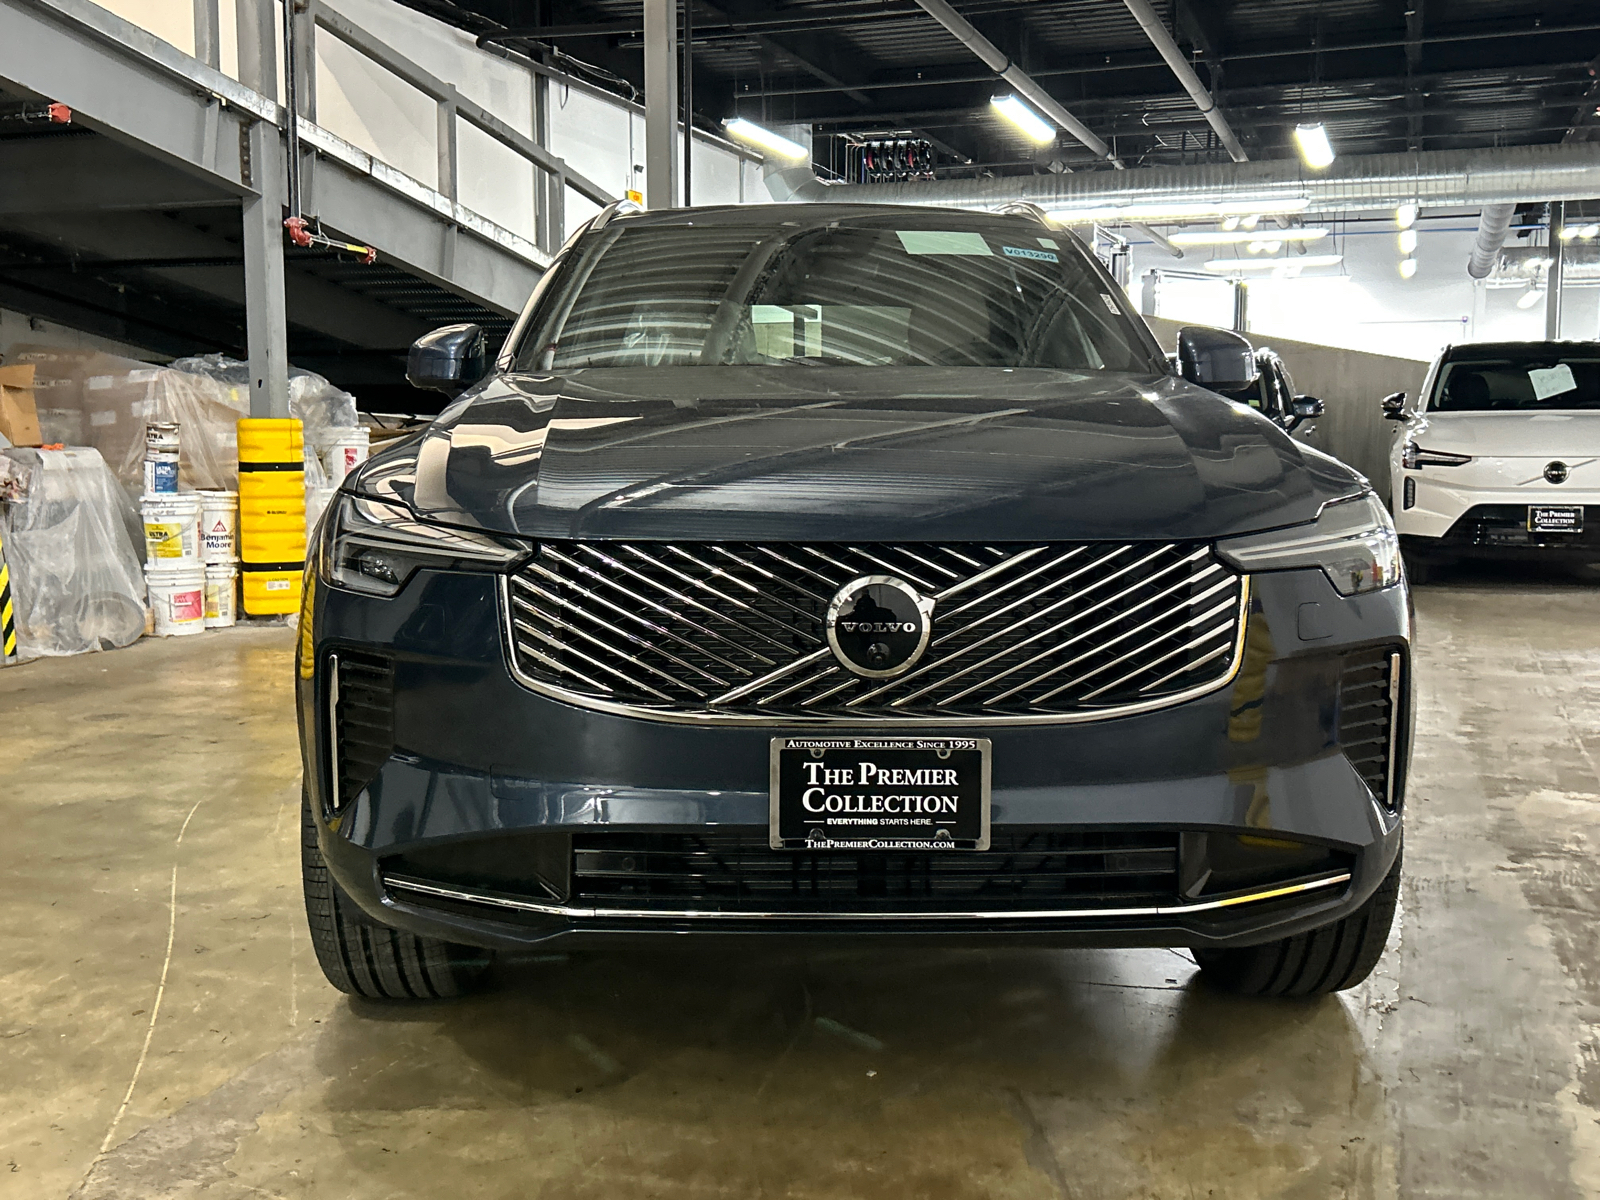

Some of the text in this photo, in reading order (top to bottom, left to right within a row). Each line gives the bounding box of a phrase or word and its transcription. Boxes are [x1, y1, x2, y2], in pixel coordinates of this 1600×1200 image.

[206, 541, 232, 549] Moore
[841, 621, 917, 633] VOLVO
[787, 739, 976, 749] AUTOMOTIVE EXCELLENCE SINCE 1995
[802, 762, 959, 785] THE PREMIER
[802, 787, 959, 813] COLLECTION
[879, 818, 909, 826] STARTS
[804, 839, 955, 849] THEPREMIERCOLLECTION.COM
